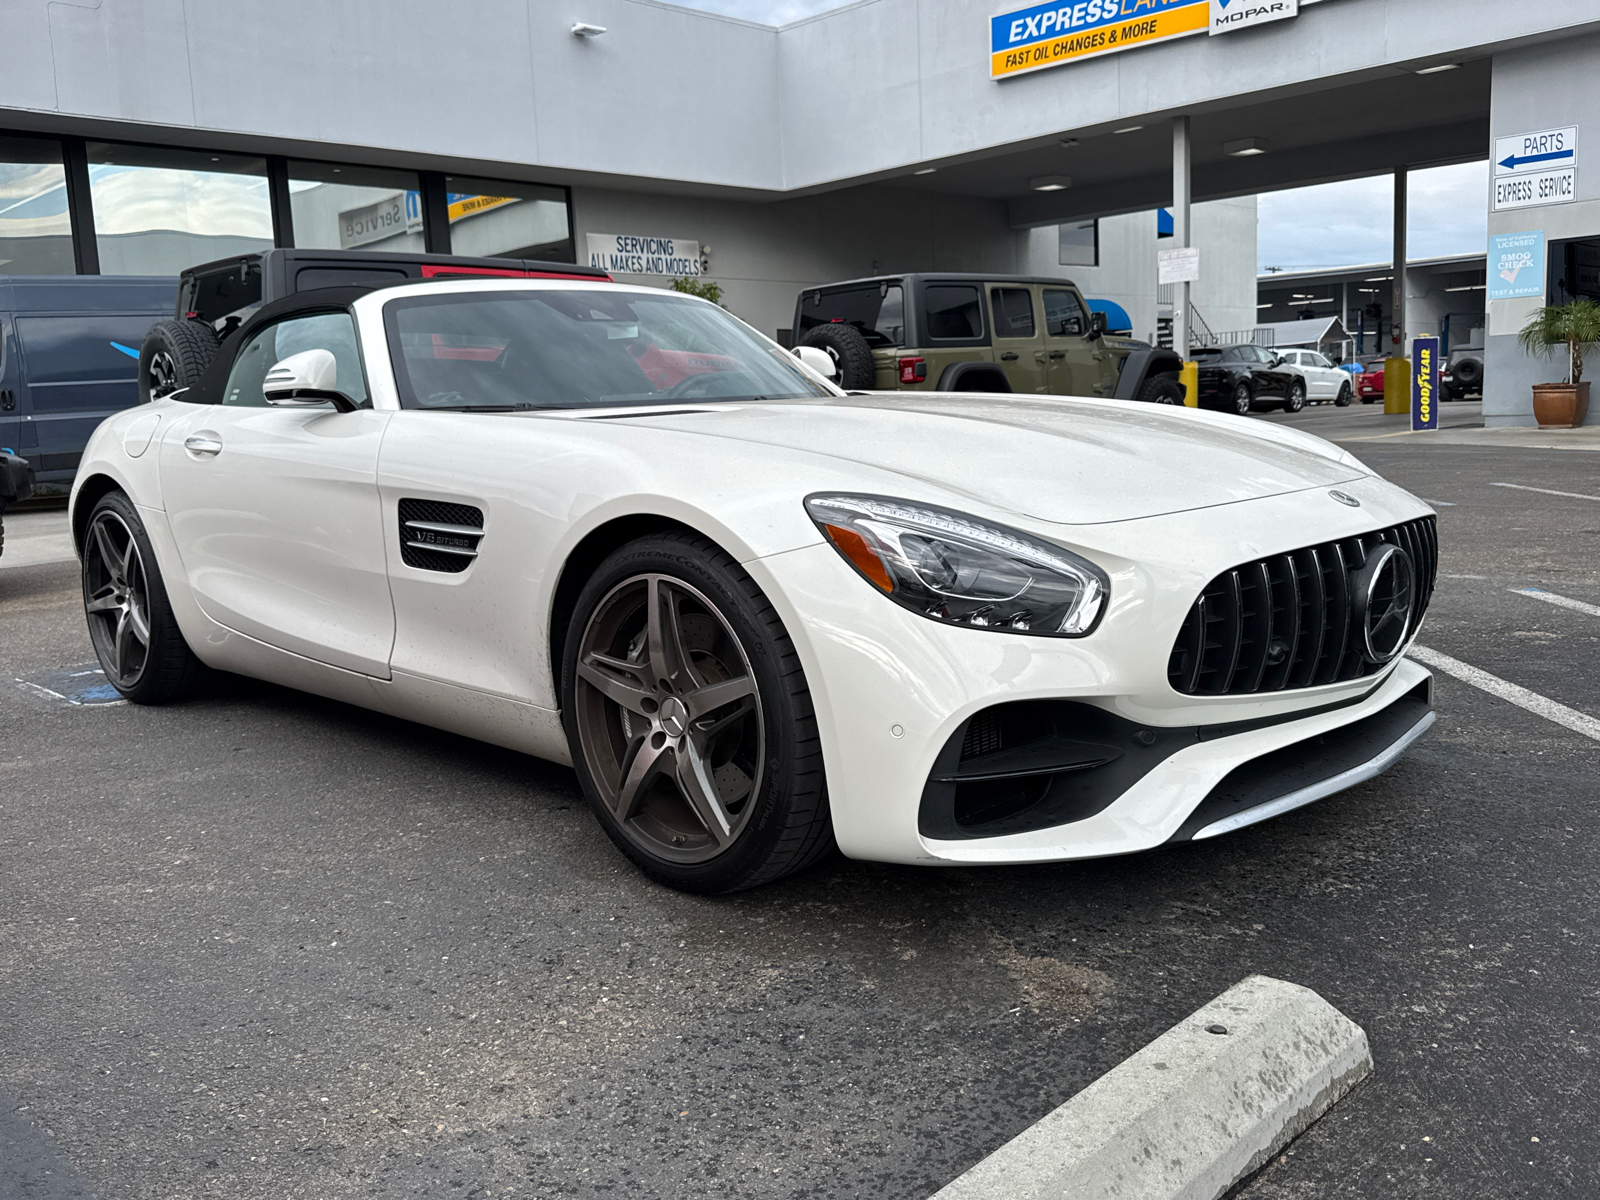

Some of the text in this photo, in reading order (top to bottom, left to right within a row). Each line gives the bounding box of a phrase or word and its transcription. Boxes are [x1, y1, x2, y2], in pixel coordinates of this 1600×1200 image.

[1215, 2, 1285, 26] MOPAR
[1005, 19, 1157, 68] FAST OIL CHANGES & MORE
[1524, 133, 1564, 155] PARTS
[1497, 175, 1572, 203] EXPRESS SERVICE
[616, 236, 674, 256] SERVICING
[1497, 239, 1535, 248] LICENSED
[591, 253, 700, 276] ALL MAKES AND MODELS
[1497, 259, 1534, 269] CHECK
[1501, 252, 1531, 261] SMOG
[1417, 348, 1433, 422] GOODYEAR
[416, 531, 469, 547] V8 BITURBO
